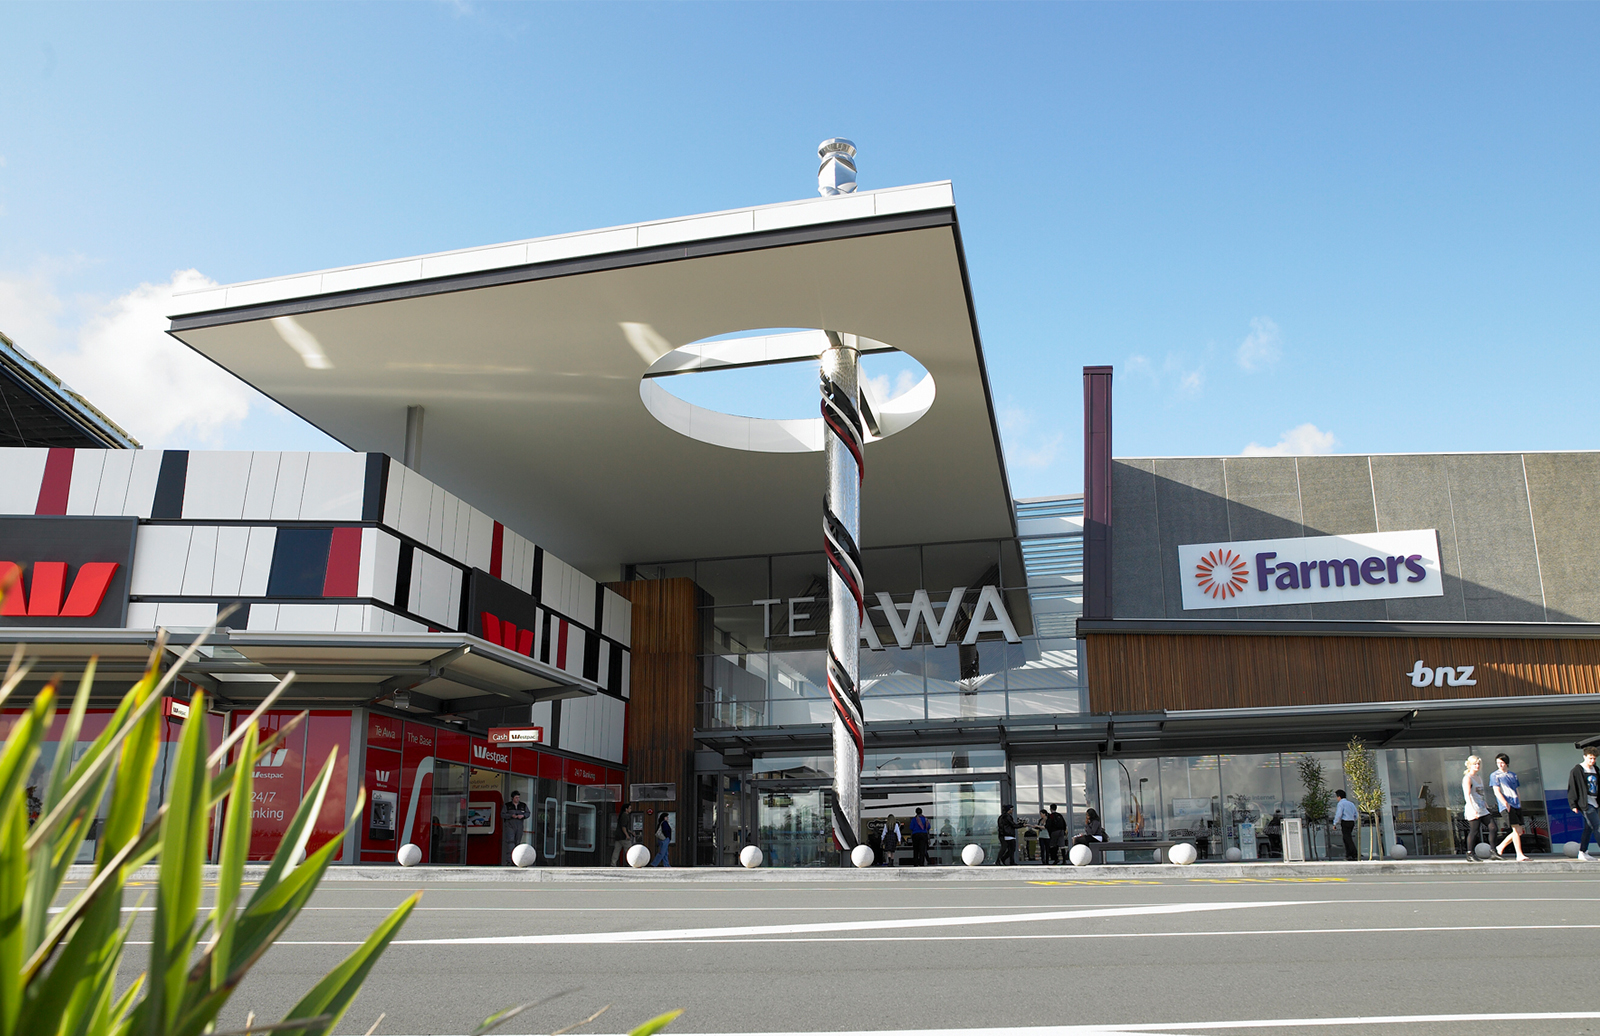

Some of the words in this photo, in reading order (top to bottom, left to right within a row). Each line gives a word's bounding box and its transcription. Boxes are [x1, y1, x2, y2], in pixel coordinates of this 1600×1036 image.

[1255, 552, 1427, 592] Farmers
[752, 597, 816, 638] TE
[1405, 660, 1477, 687] bnz
[375, 725, 381, 737] Te
[382, 727, 396, 739] Awa
[407, 732, 418, 743] The
[419, 735, 432, 747] Base
[492, 733, 507, 741] Cash
[473, 744, 508, 764] Westpac
[250, 791, 276, 804] 24/7
